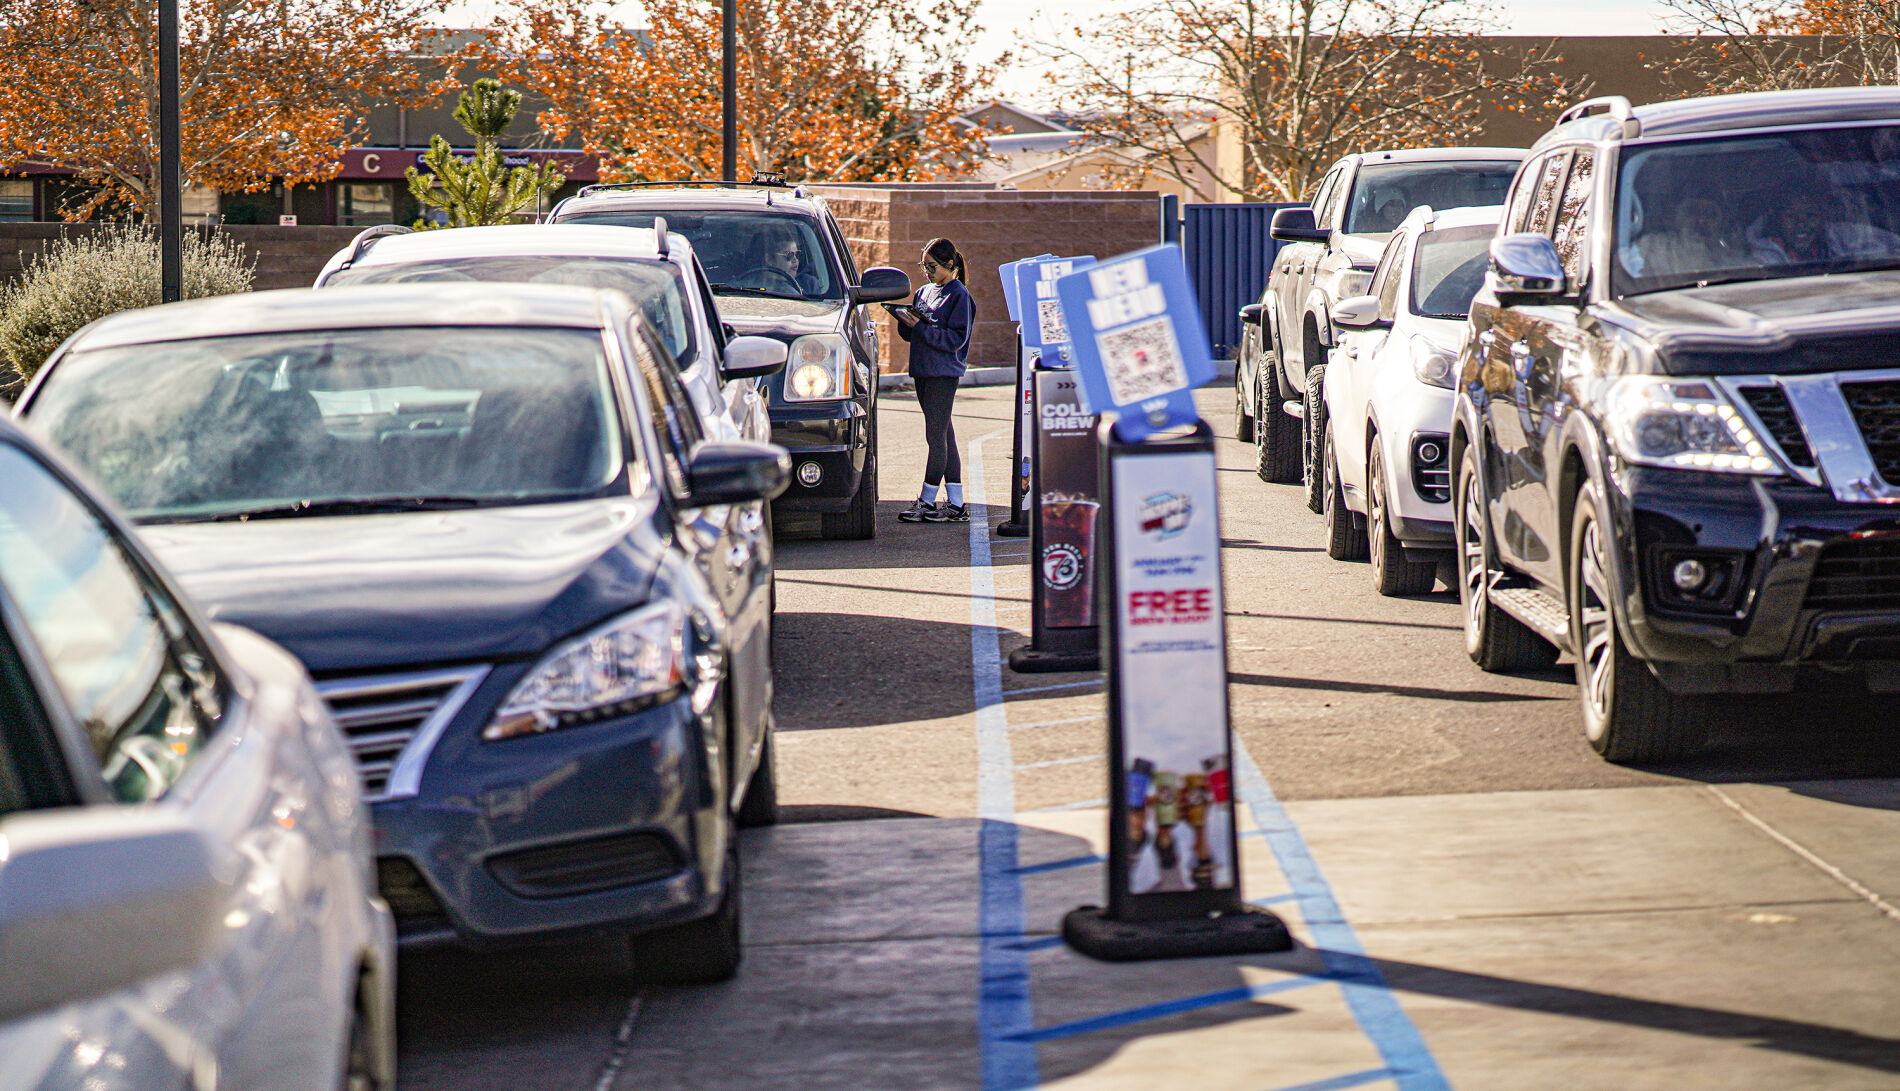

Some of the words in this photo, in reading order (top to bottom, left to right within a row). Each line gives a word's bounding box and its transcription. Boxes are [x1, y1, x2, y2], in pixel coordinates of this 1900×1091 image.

[363, 153, 381, 173] C
[1042, 403, 1093, 417] COLD
[1042, 416, 1095, 430] BREW
[1129, 588, 1212, 615] FREE
